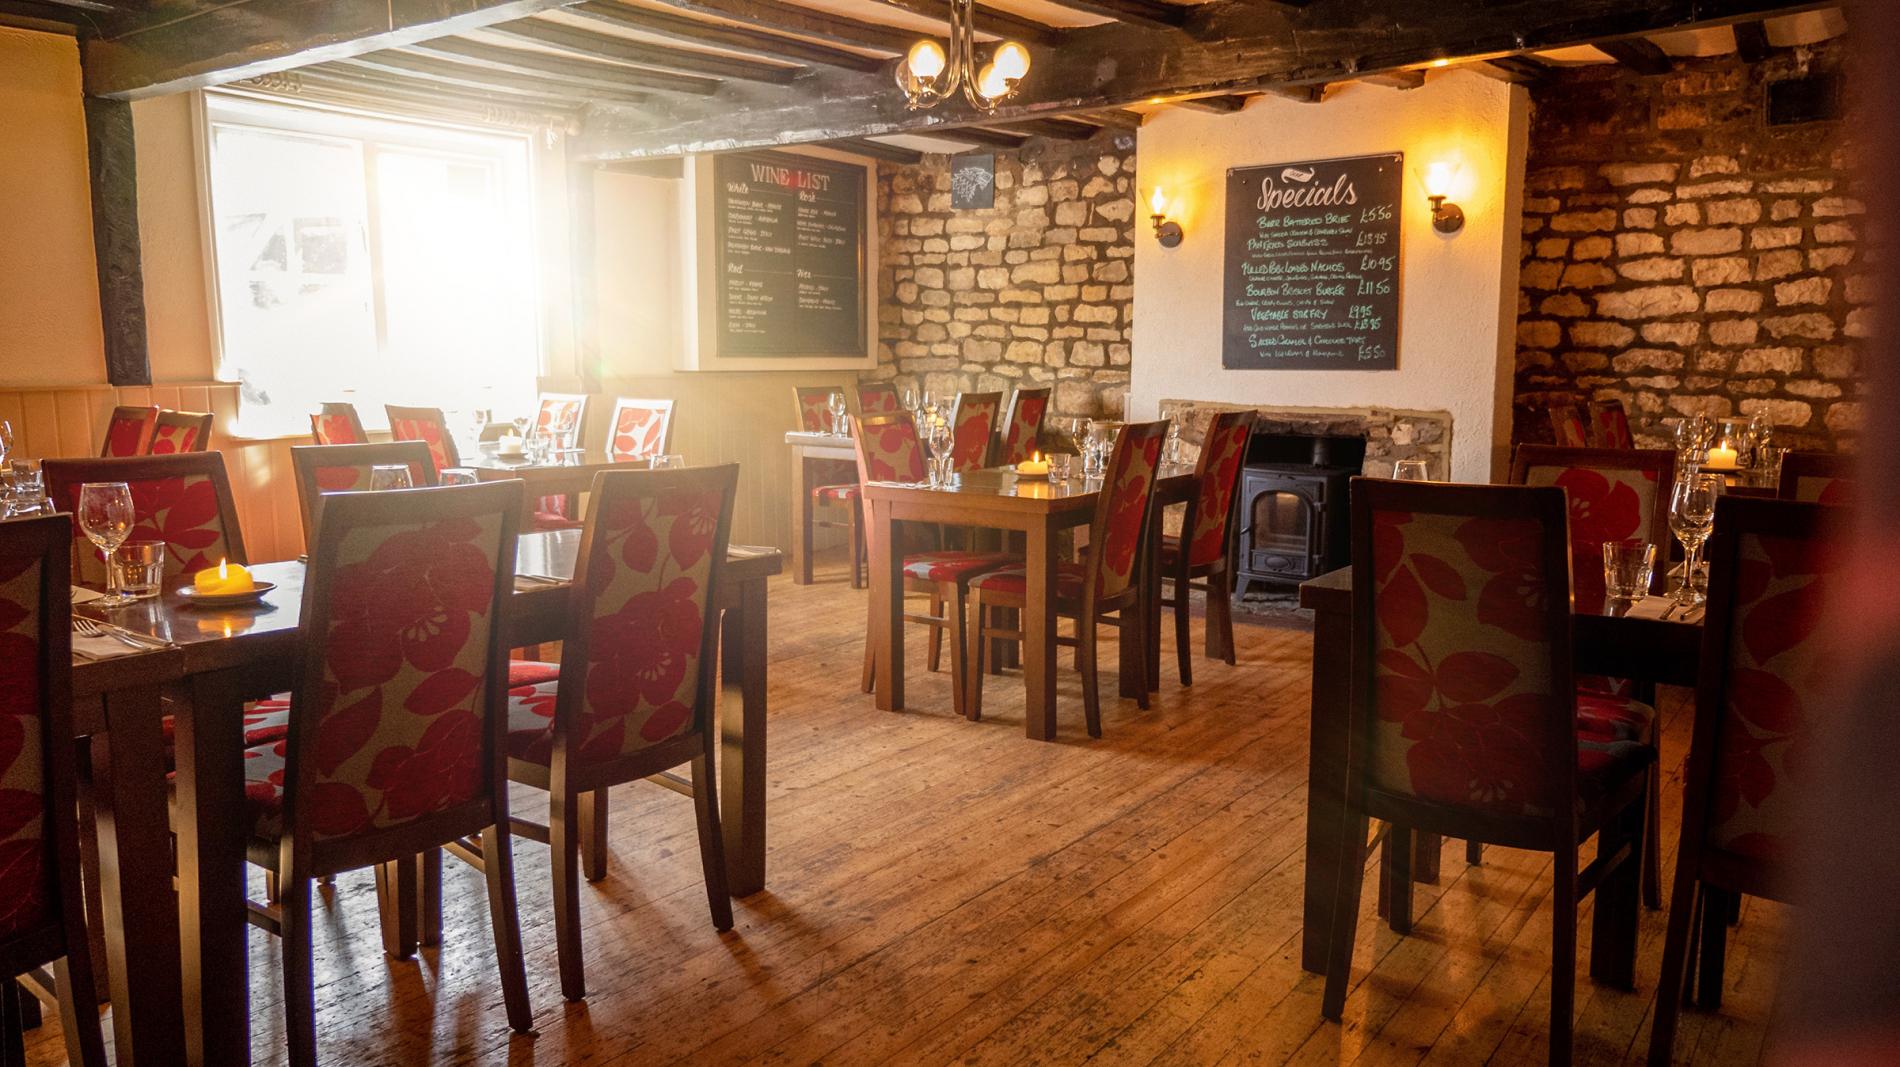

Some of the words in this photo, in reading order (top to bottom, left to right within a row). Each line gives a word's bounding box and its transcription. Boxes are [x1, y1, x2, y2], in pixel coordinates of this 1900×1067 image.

[751, 163, 790, 187] WINE
[797, 170, 830, 191] LIST
[1257, 173, 1358, 212] Specials
[727, 262, 743, 274] Red
[1311, 260, 1345, 272] NACHOS
[1316, 282, 1345, 296] BURGER
[1250, 307, 1289, 320] VEGETABLE
